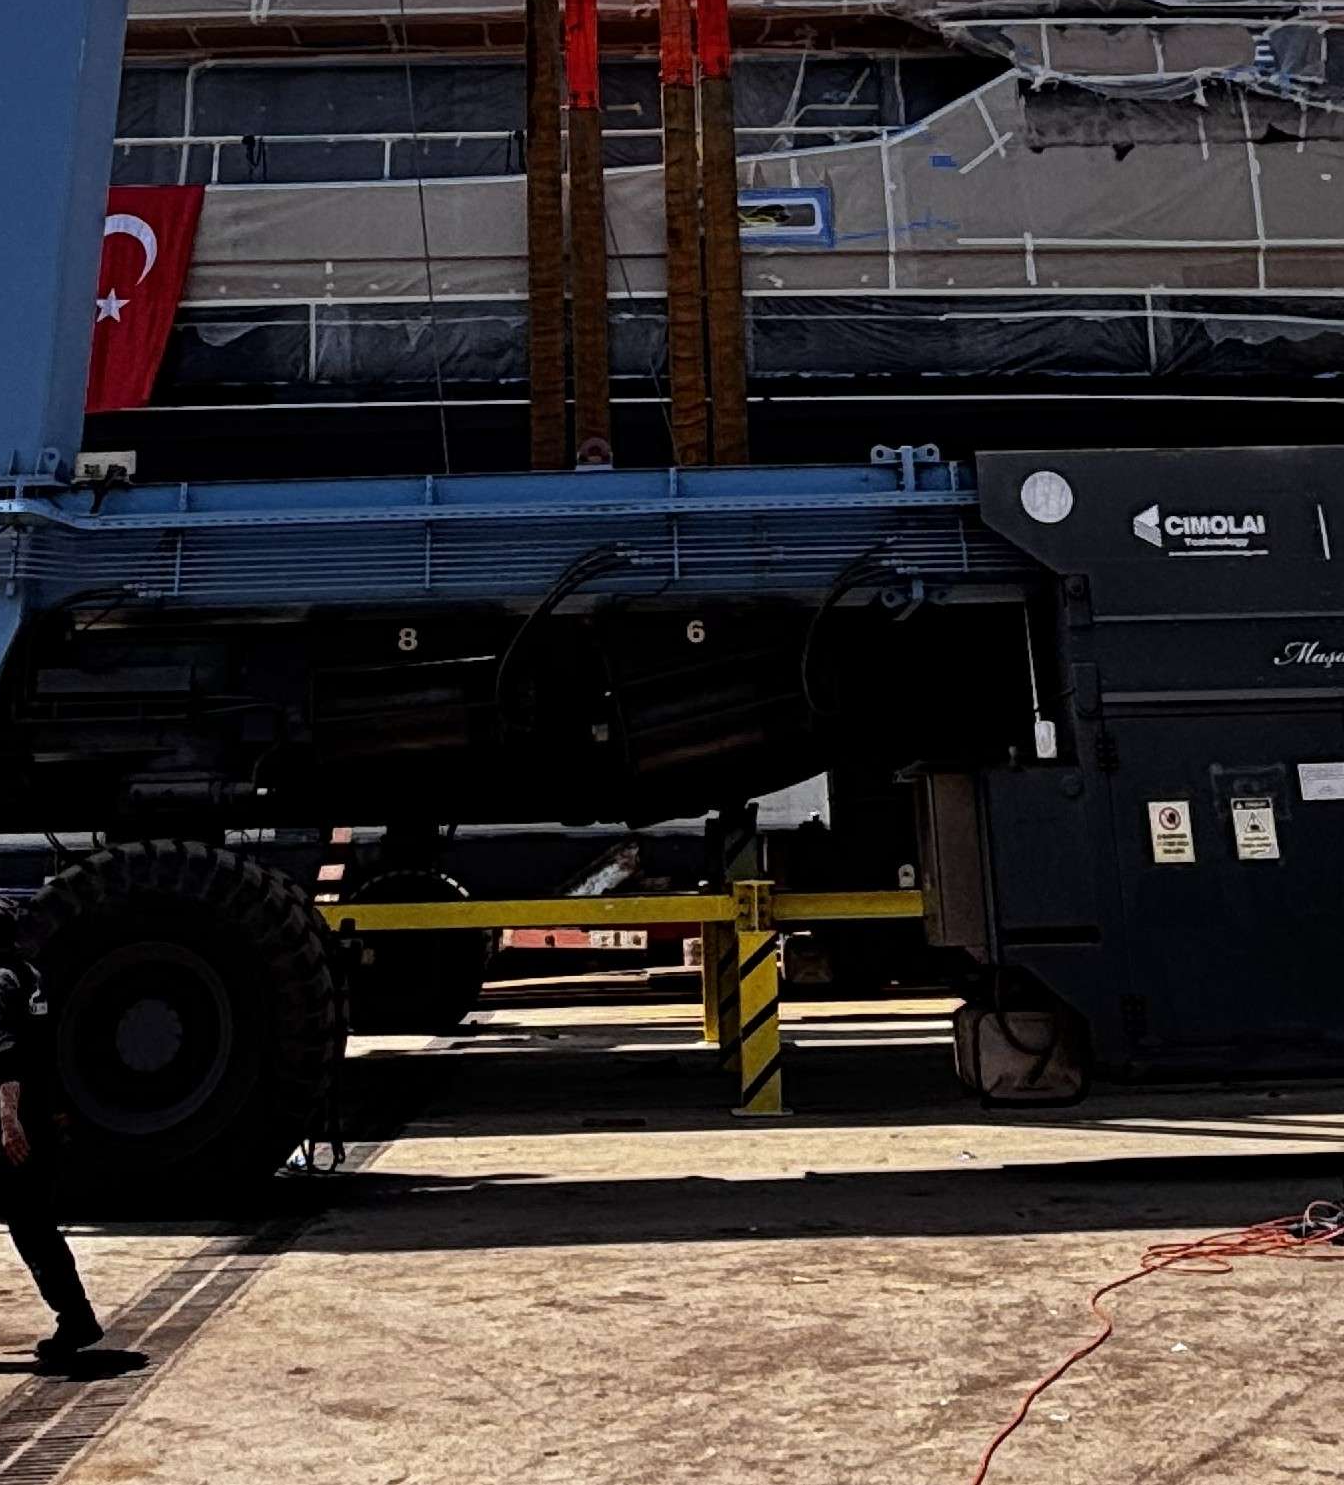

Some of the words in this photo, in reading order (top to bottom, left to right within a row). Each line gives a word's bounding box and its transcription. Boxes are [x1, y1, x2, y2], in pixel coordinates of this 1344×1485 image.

[1164, 515, 1266, 535] CIMOLAI
[398, 627, 418, 651] 8
[686, 619, 705, 643] 6
